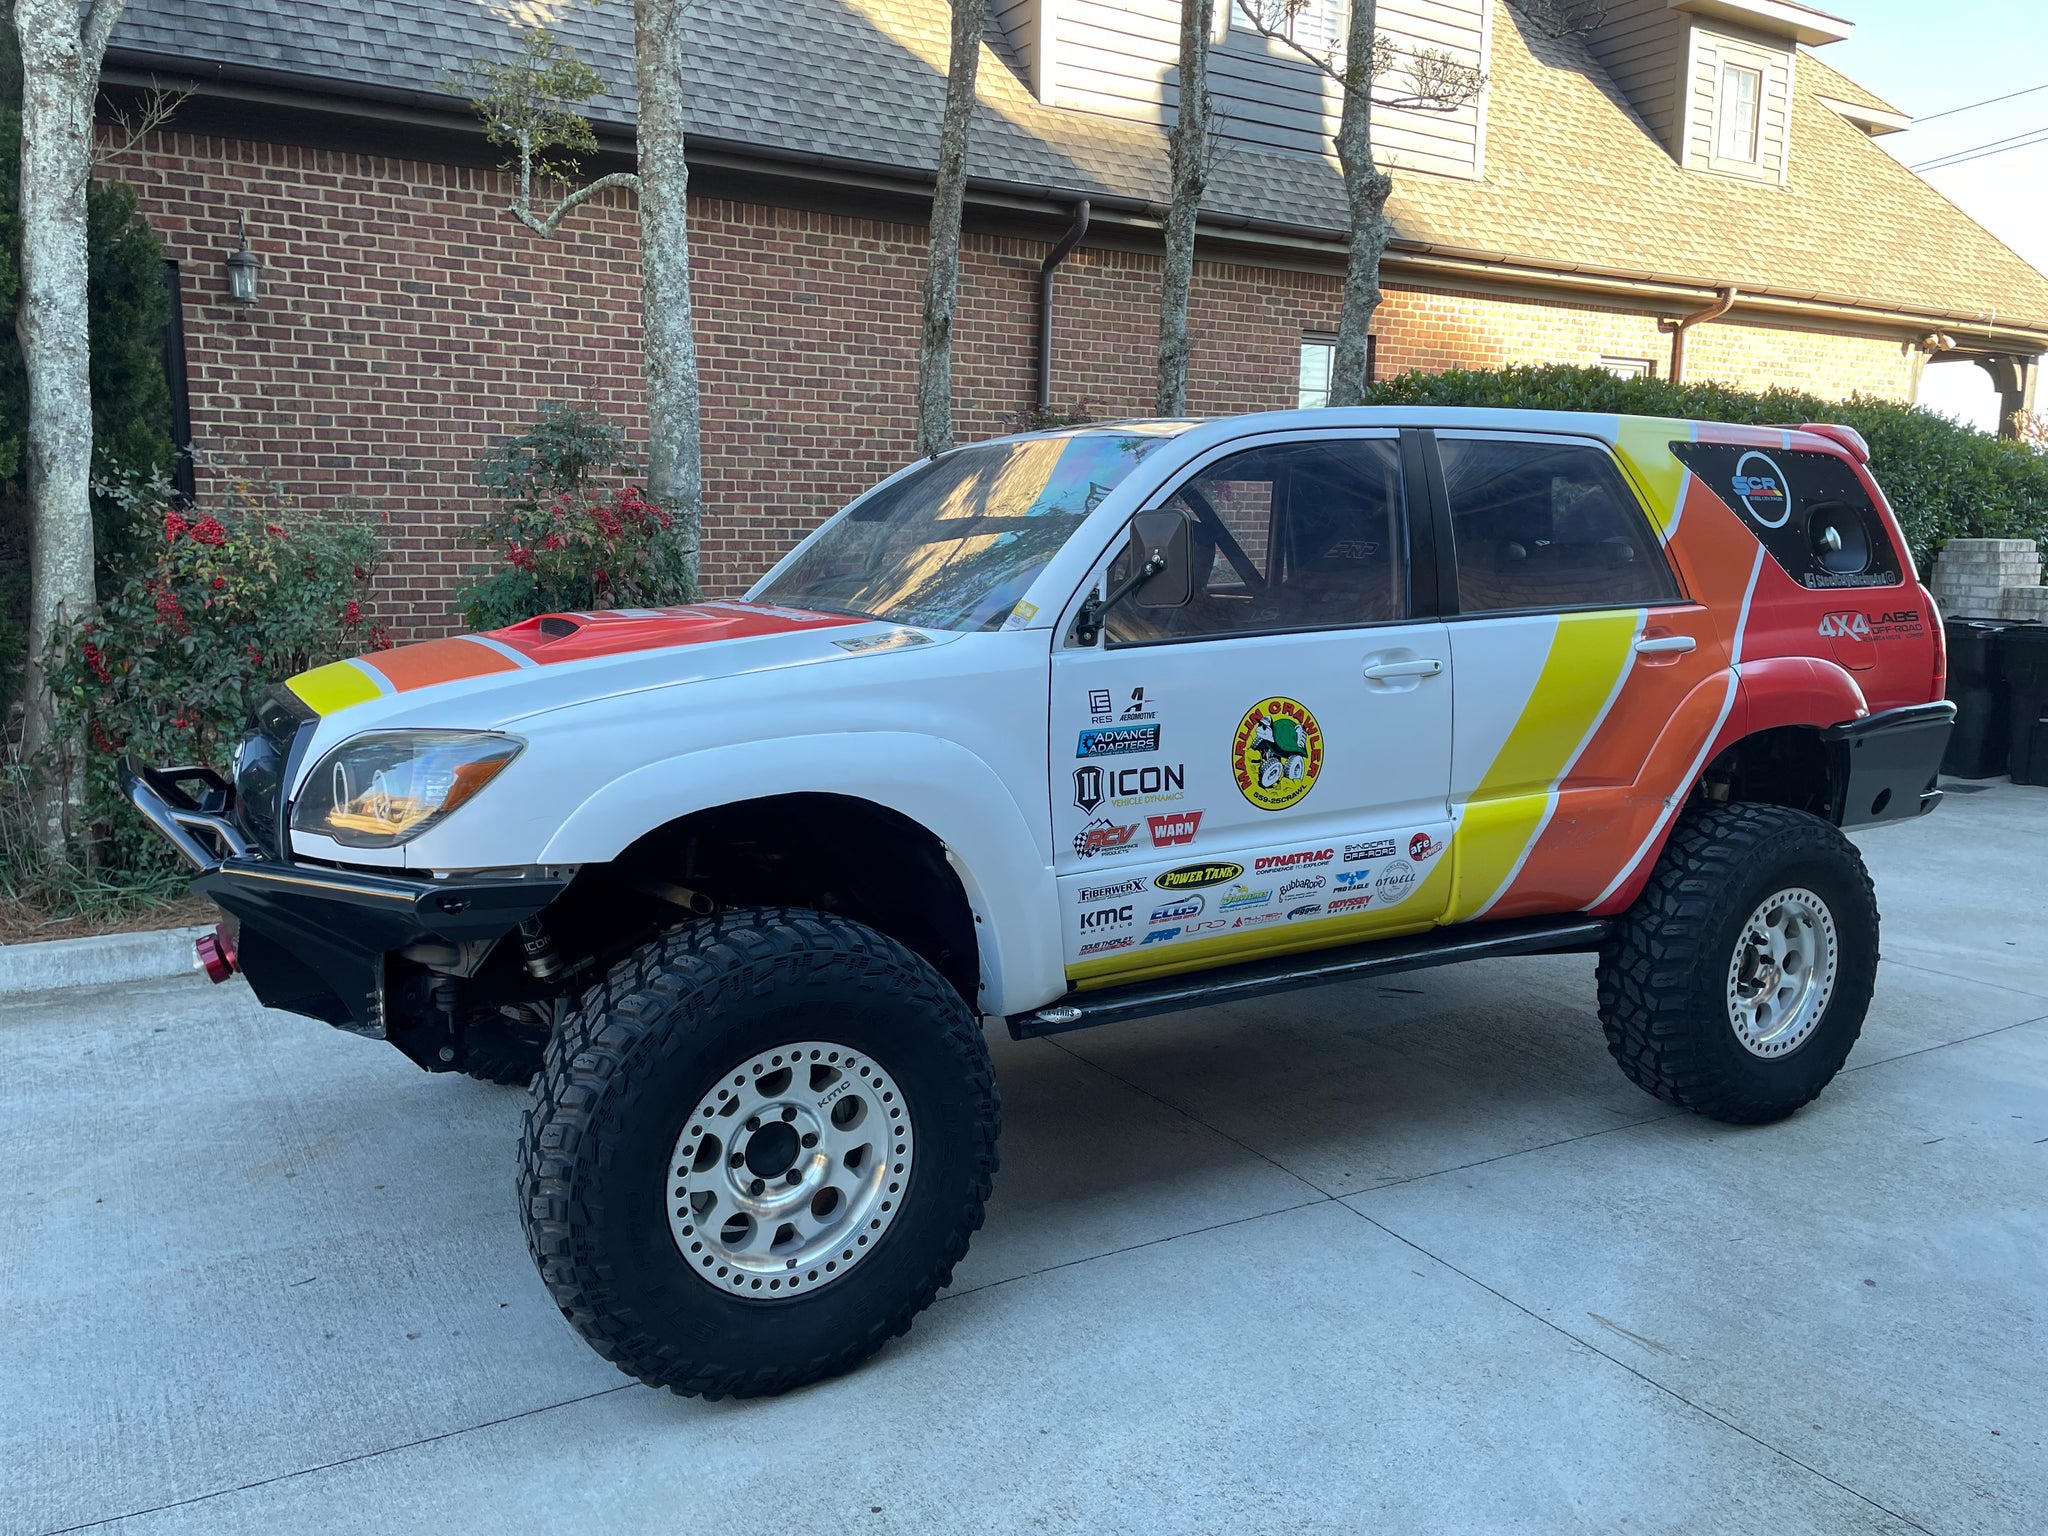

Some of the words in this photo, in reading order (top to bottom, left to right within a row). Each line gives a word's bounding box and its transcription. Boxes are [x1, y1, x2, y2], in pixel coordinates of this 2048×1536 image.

[1731, 476, 1777, 495] SCR
[1818, 614, 1870, 641] 4X4
[1866, 611, 1919, 625] LABS
[1871, 623, 1923, 635] OFF-ROAD
[1091, 715, 1113, 725] RES
[1119, 711, 1157, 722] AEROMOTIVE
[1095, 727, 1155, 743] ADVANCE
[1088, 739, 1154, 754] ADAPTERS
[1235, 708, 1264, 791] MARLIN
[1268, 701, 1321, 779] CRAWLER
[1109, 763, 1184, 797] ICON
[1111, 796, 1142, 808] VEHICLE
[1144, 792, 1185, 804] DYNAMICS
[1252, 784, 1308, 804] 559-25CRAWL
[1084, 823, 1140, 849] RCV
[1154, 821, 1194, 839] WARN
[1101, 843, 1139, 852] PERFORMANCE
[1344, 837, 1395, 852] SYNDICATE
[1410, 838, 1431, 856] aFe
[1421, 841, 1443, 861] POWER
[1101, 849, 1129, 857] PRODUCTS
[1254, 848, 1334, 870] DYNATRAC
[1164, 871, 1204, 887] POWER
[1205, 865, 1235, 881] TANK
[1256, 865, 1294, 876] CONFIDENCE
[1302, 860, 1330, 869] EXPLORE
[1332, 886, 1348, 894] PRO
[1347, 882, 1371, 892] EAGLE
[1375, 873, 1416, 887] OTWELL
[1081, 879, 1143, 901] FIBERWERX
[1327, 904, 1368, 914] BATTERY
[1328, 895, 1374, 909] ODYSSEY
[1080, 905, 1133, 929] KMC
[1150, 905, 1199, 920] ECGS
[1080, 922, 1133, 936] WHEELS
[523, 935, 551, 952] ICON
[817, 1081, 851, 1108] KMC
